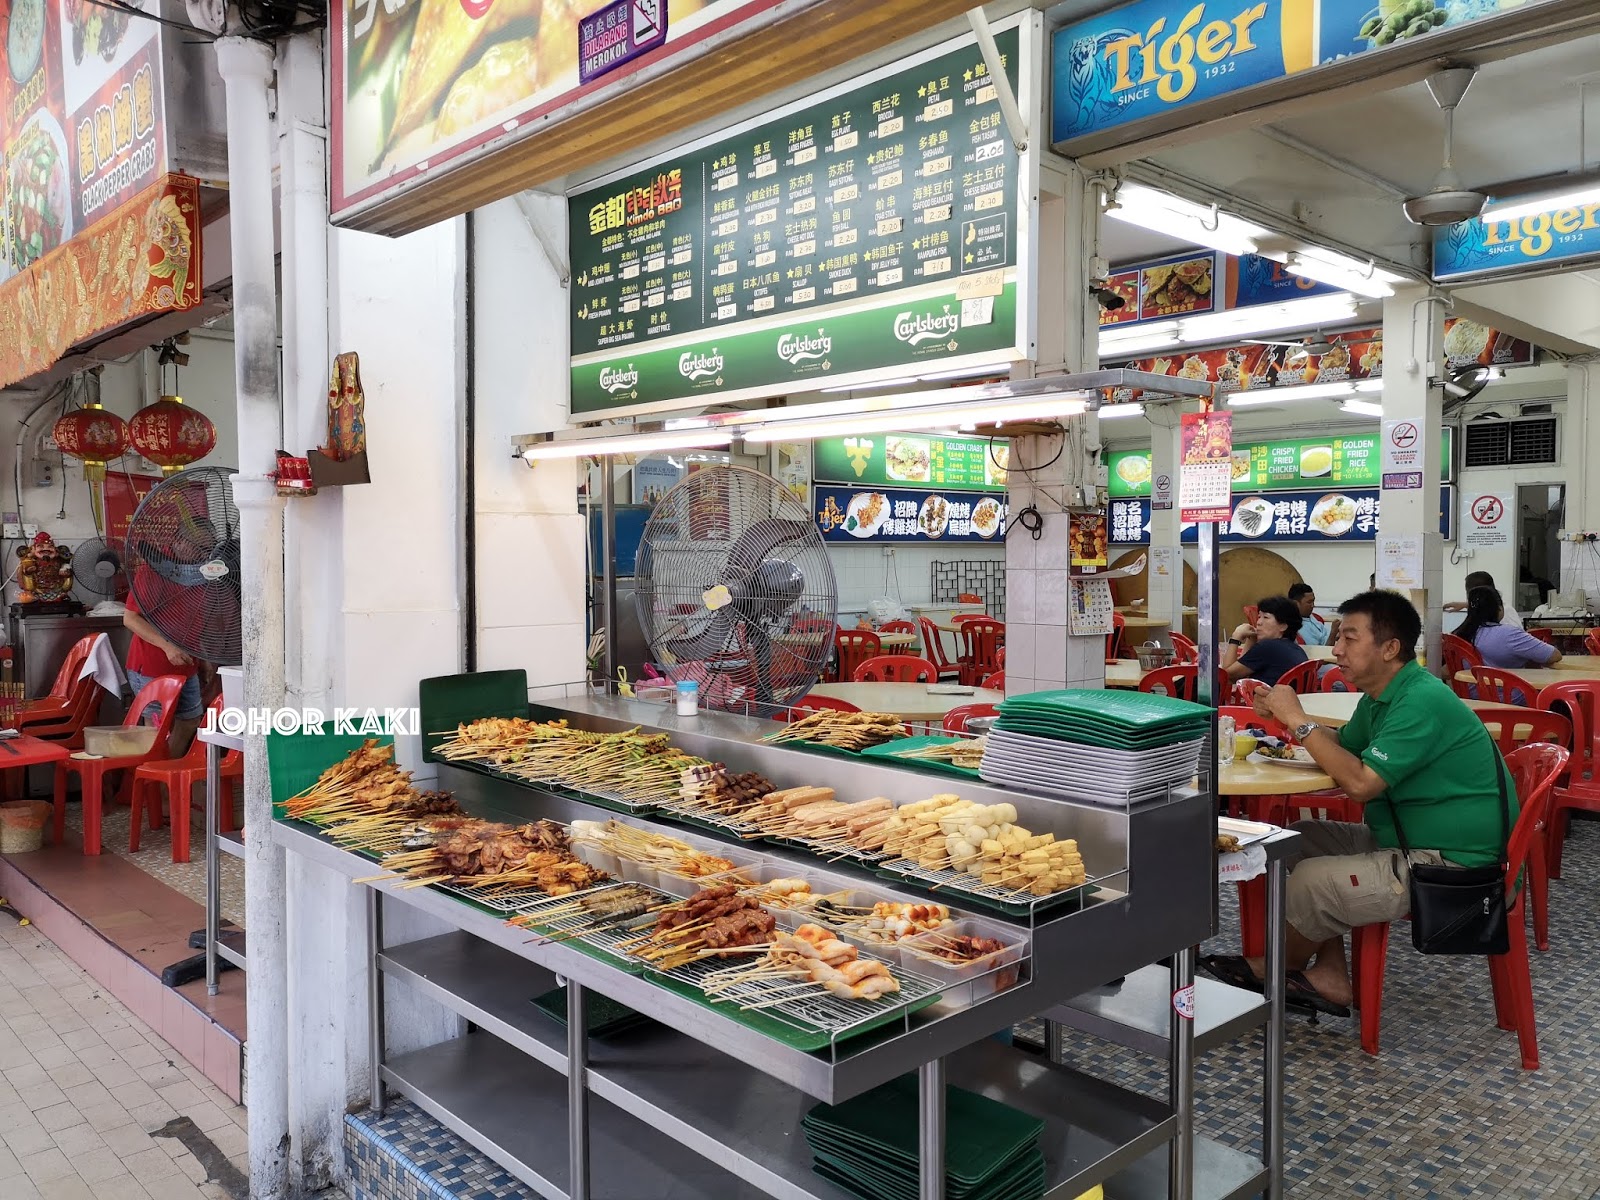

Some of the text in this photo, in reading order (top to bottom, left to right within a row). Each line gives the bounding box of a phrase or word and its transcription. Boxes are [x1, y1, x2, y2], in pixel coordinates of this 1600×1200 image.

[584, 22, 628, 58] DILARANG
[585, 41, 628, 74] MEROKOK
[1104, 2, 1268, 103] Tiger
[963, 80, 979, 93] OYSTER
[1116, 61, 1236, 106] SINCE 1932
[871, 93, 901, 114] 西兰花
[927, 93, 940, 105] PETAI
[965, 97, 976, 106] RM
[831, 111, 851, 129] 茄子
[969, 112, 1002, 135] 金包银
[788, 125, 814, 144] 洋角豆
[838, 125, 851, 136] PLANT
[868, 130, 878, 139] RM
[971, 133, 983, 145] FISH
[918, 130, 949, 151] 多春鱼
[876, 143, 905, 164] 贵妃鲍
[964, 145, 1004, 163] RM 2.00
[82, 138, 155, 215] BLACK PEPPER CRABS
[828, 160, 855, 179] 苏东仔
[962, 163, 1006, 188] 芝士豆付
[788, 173, 814, 190] 苏东肉
[868, 182, 877, 191] RM
[912, 178, 954, 201] 海鲜豆付
[979, 179, 1004, 194] BEANCURD
[912, 192, 954, 211] SEAFOOD BEANCURD
[963, 203, 974, 212] RM
[626, 198, 682, 227] Kimdo BBQ
[874, 208, 896, 222] CRAB STICK
[913, 210, 947, 225] RM 2.20
[784, 217, 817, 237] 芝士热狗
[881, 222, 899, 233] 2.20
[920, 230, 950, 249] 甘榜鱼
[977, 233, 1004, 243] RECOMMEND
[1488, 233, 1583, 255] SINCE 1932
[917, 246, 948, 260] KAMPUNG FISH
[976, 255, 989, 263] MUST
[828, 267, 852, 280] SMOKE DUCK
[913, 267, 924, 276] RM
[742, 271, 780, 290] 日本八爪鱼
[867, 277, 877, 286] RM
[893, 309, 959, 342] Carlsberg
[777, 331, 832, 362] Carlsberg
[678, 351, 725, 378] Carlsberg
[599, 367, 639, 391] Carlsberg
[966, 444, 983, 453] CRABS
[1271, 447, 1296, 456] CRISPY
[1343, 440, 1374, 449] GOLDEN
[1273, 456, 1294, 465] FRIED
[1347, 449, 1369, 458] FRIED
[1268, 465, 1299, 474] CHICKEN
[1349, 458, 1366, 467] RICE
[894, 500, 918, 518] 招牌
[1113, 515, 1142, 528] 招牌
